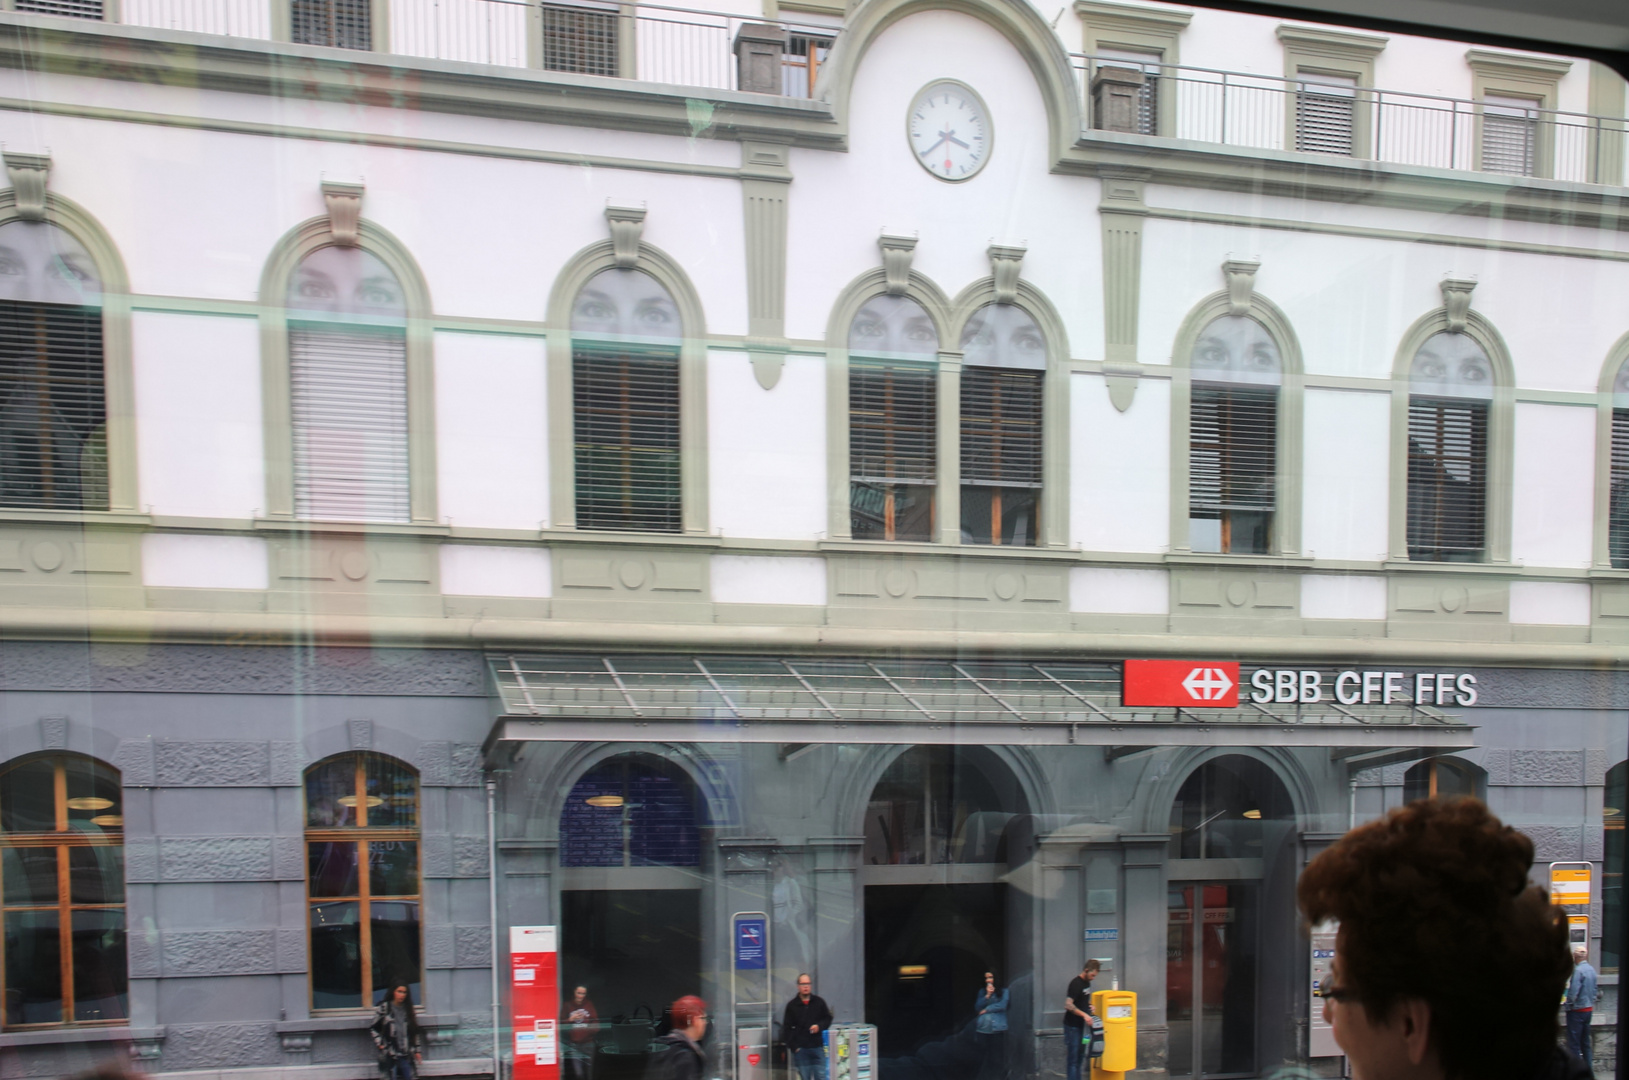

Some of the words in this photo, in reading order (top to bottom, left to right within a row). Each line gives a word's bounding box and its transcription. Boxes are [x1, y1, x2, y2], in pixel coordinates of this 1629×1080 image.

[1250, 669, 1322, 704] SBB
[1335, 670, 1405, 706] CFF
[1415, 673, 1478, 707] FFS
